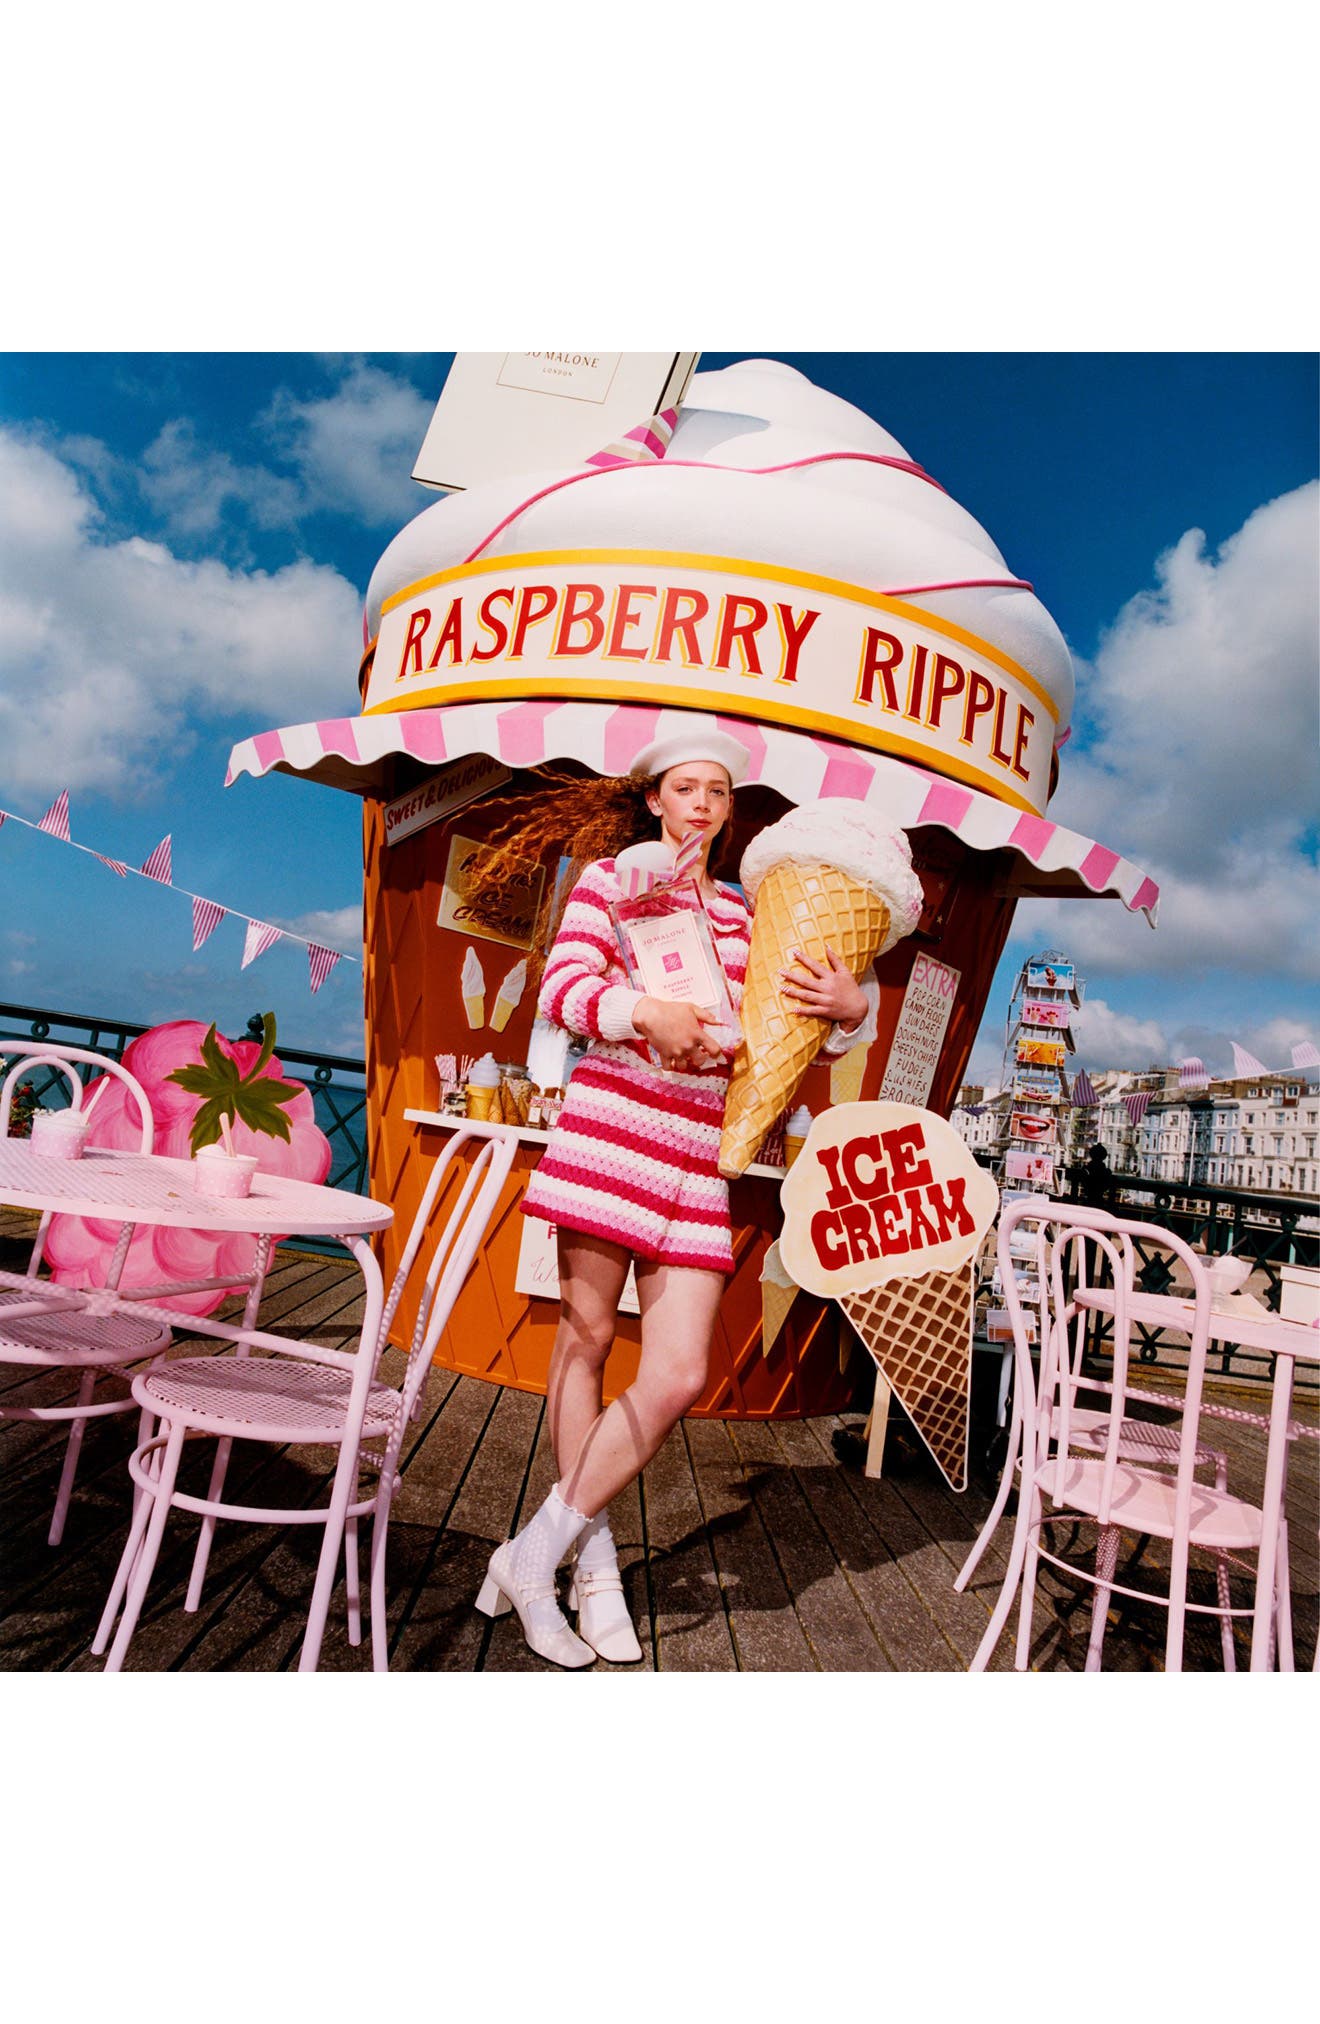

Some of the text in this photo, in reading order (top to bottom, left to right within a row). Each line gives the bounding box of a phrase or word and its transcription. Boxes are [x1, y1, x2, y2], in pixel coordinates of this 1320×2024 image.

[545, 352, 600, 369] MALONE
[397, 583, 1034, 782] RASPBERRY RIPPLE
[387, 793, 425, 831] SWEET
[425, 785, 436, 809] &
[913, 955, 957, 1000] EXTRA
[905, 998, 945, 1025] CANDY FLOSS
[893, 1040, 937, 1066] CHEESY CHIPS
[895, 1058, 926, 1078] FUDGE
[816, 1122, 934, 1209] ICE
[810, 1177, 976, 1271] CREAM
